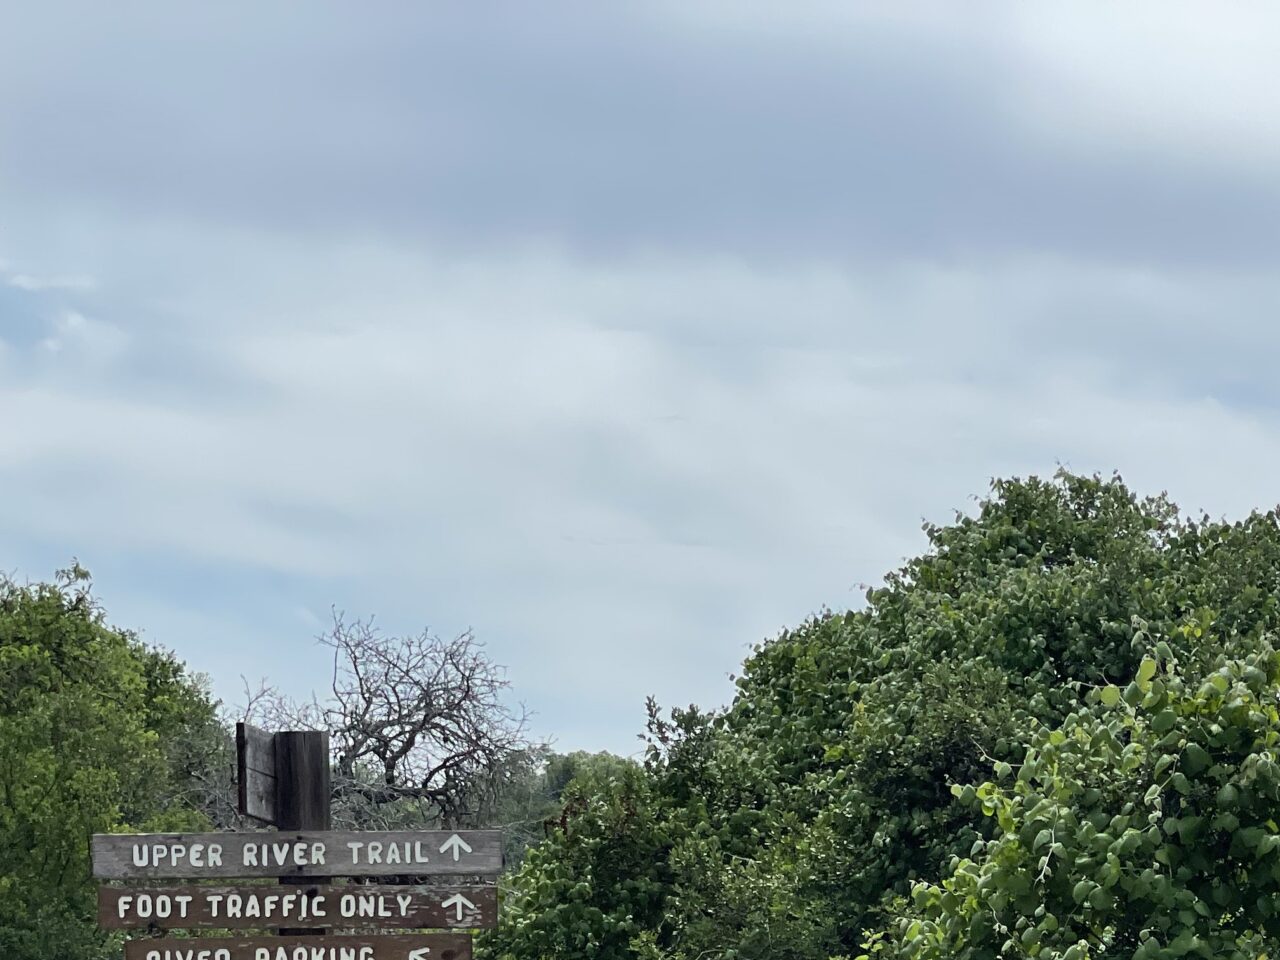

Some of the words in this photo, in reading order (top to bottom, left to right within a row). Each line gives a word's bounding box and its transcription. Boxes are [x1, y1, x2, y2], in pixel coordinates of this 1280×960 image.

[132, 843, 223, 868] UPPER
[243, 842, 326, 867] RIVER
[347, 841, 429, 865] TRAIL
[118, 895, 193, 919] FOOT
[207, 894, 326, 919] TRAFFIC
[340, 894, 412, 918] ONLY
